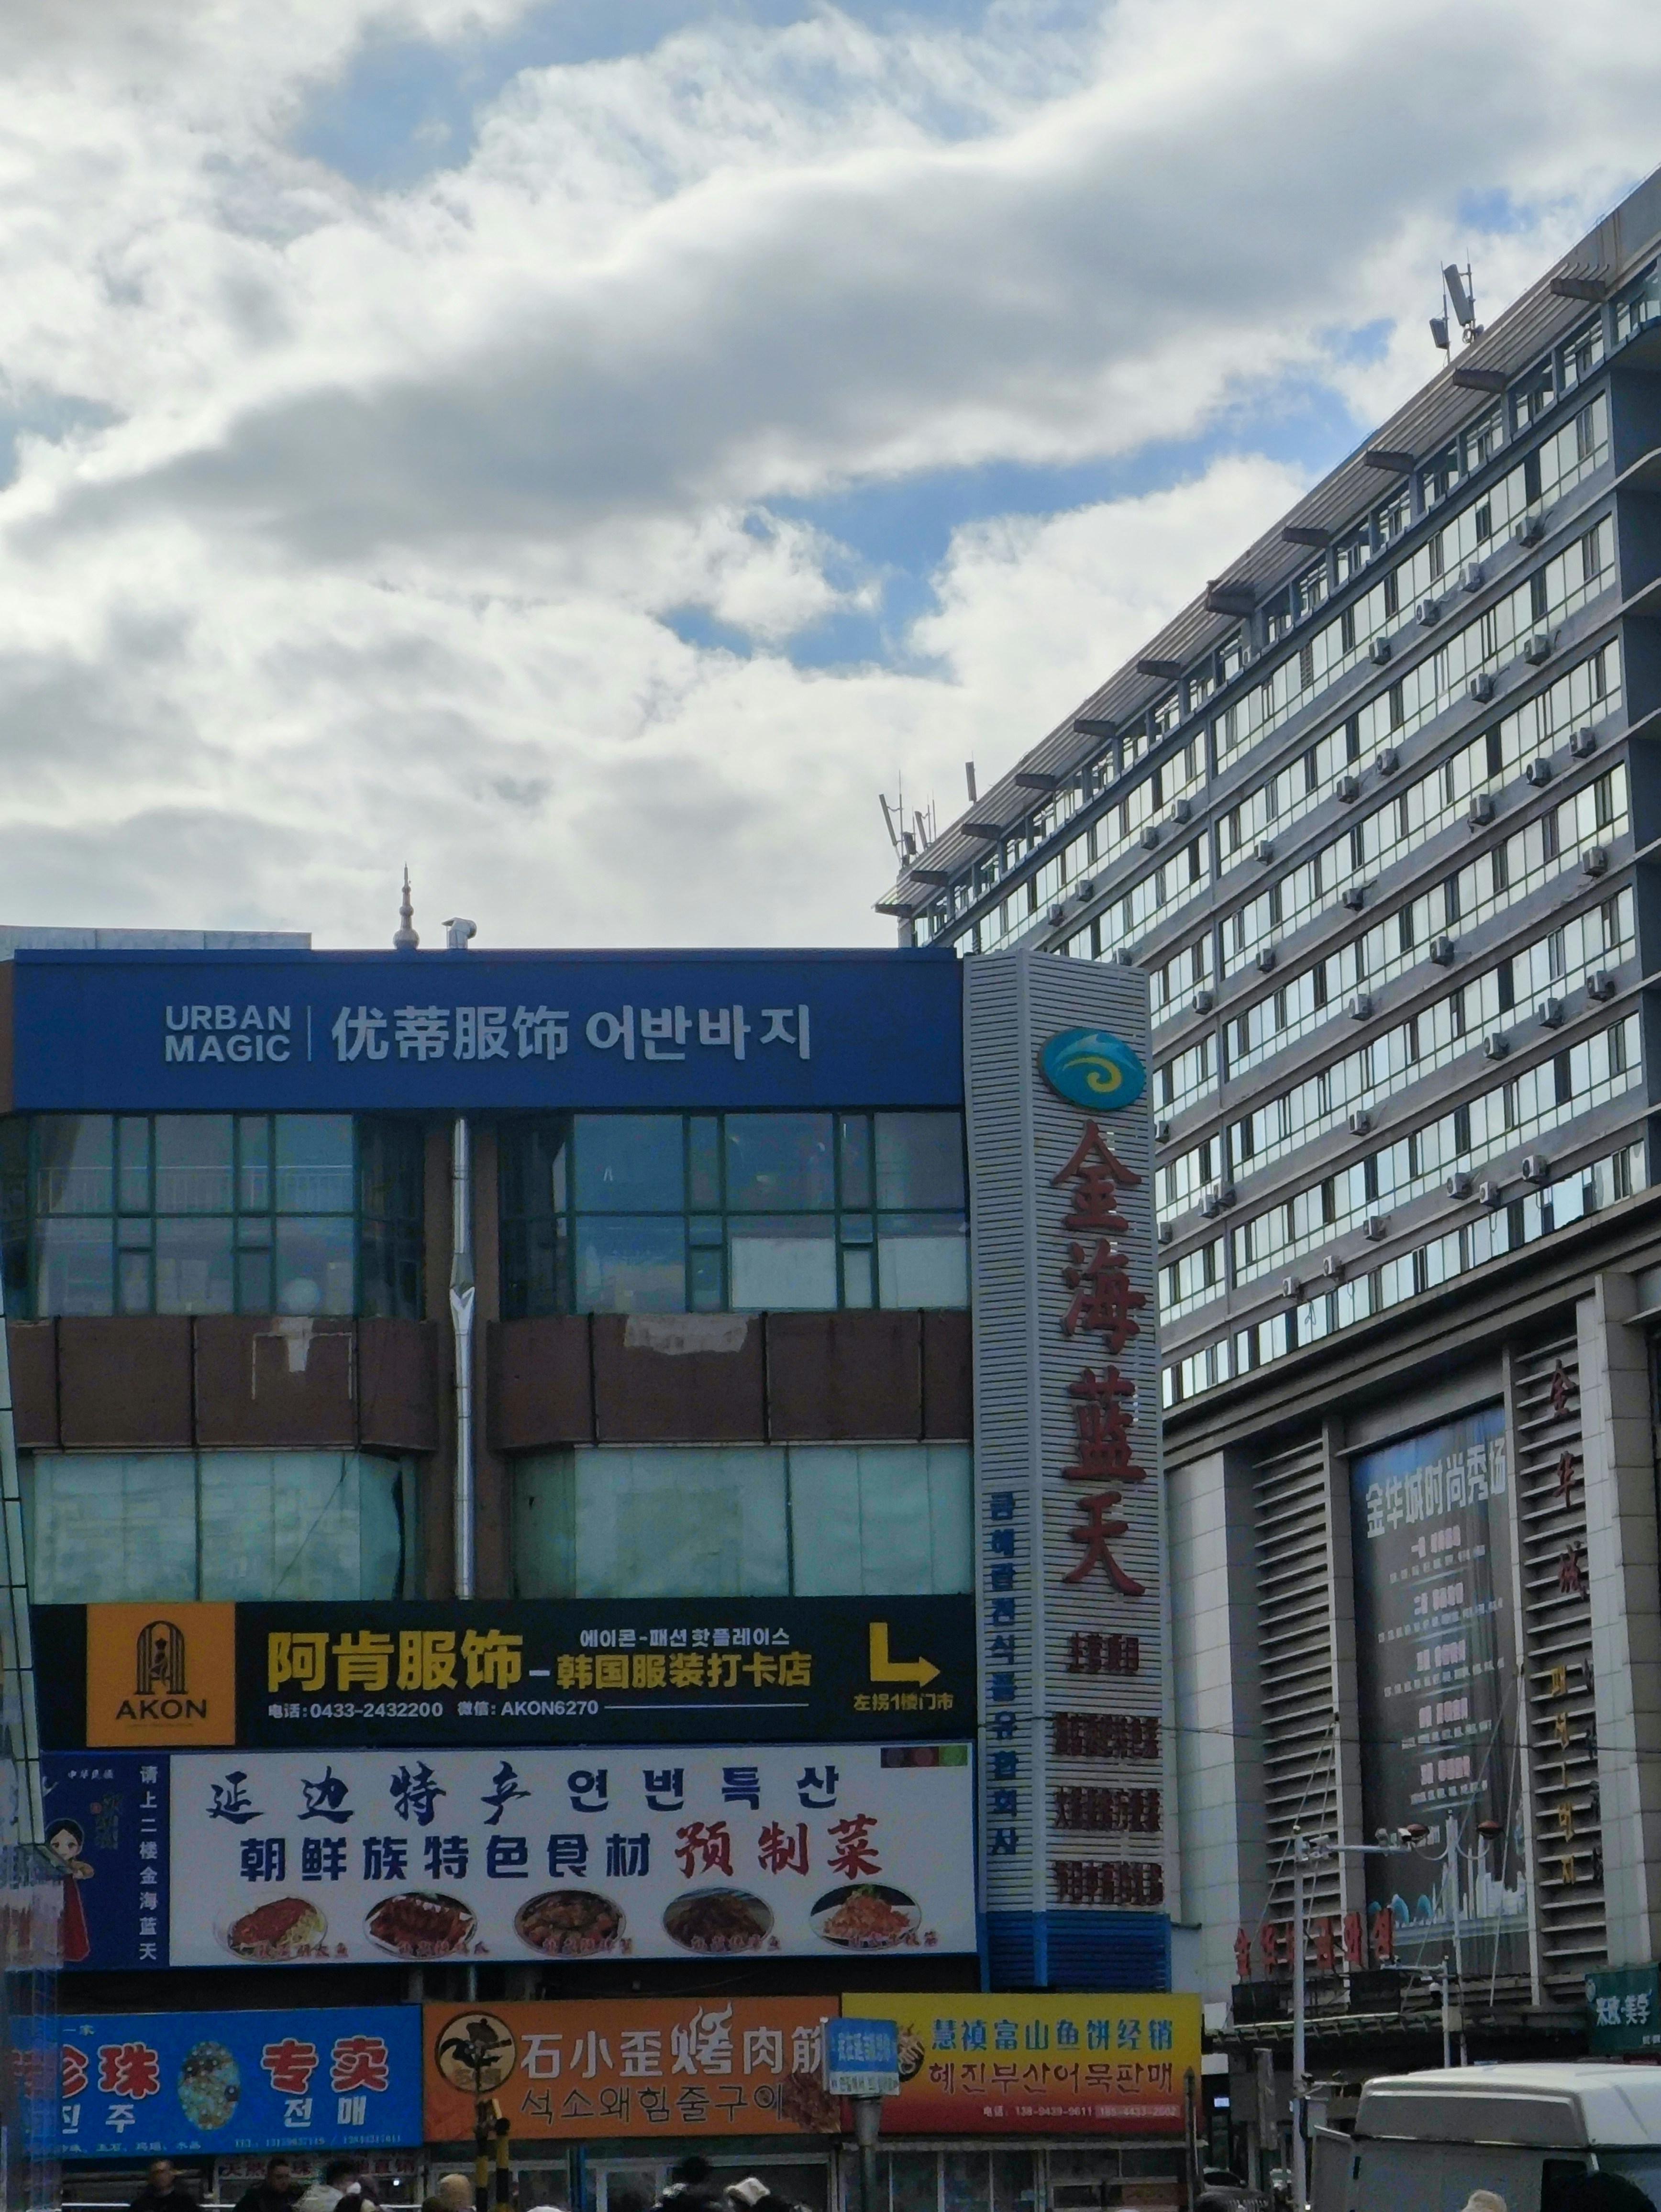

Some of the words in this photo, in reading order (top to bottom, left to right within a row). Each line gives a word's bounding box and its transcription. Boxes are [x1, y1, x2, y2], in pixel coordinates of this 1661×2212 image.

[166, 1005, 291, 1031] URBAN
[331, 1005, 570, 1062] 优蒂服饰
[586, 1004, 811, 1061] 어반바지
[165, 1034, 291, 1063] MAGIC
[1366, 1437, 1506, 1538] 金华城时尚秀场
[267, 1627, 523, 1693] 阿肯服饰
[691, 1627, 790, 1648] 핫플레이스
[116, 1699, 207, 1720] AKON
[853, 1692, 953, 1712] 左拐1楼门市
[139, 1765, 158, 1961] 请上二楼金海蓝天
[675, 1813, 882, 1880] 预制菜
[261, 2035, 390, 2096] 专卖
[284, 2095, 367, 2129] 전매
